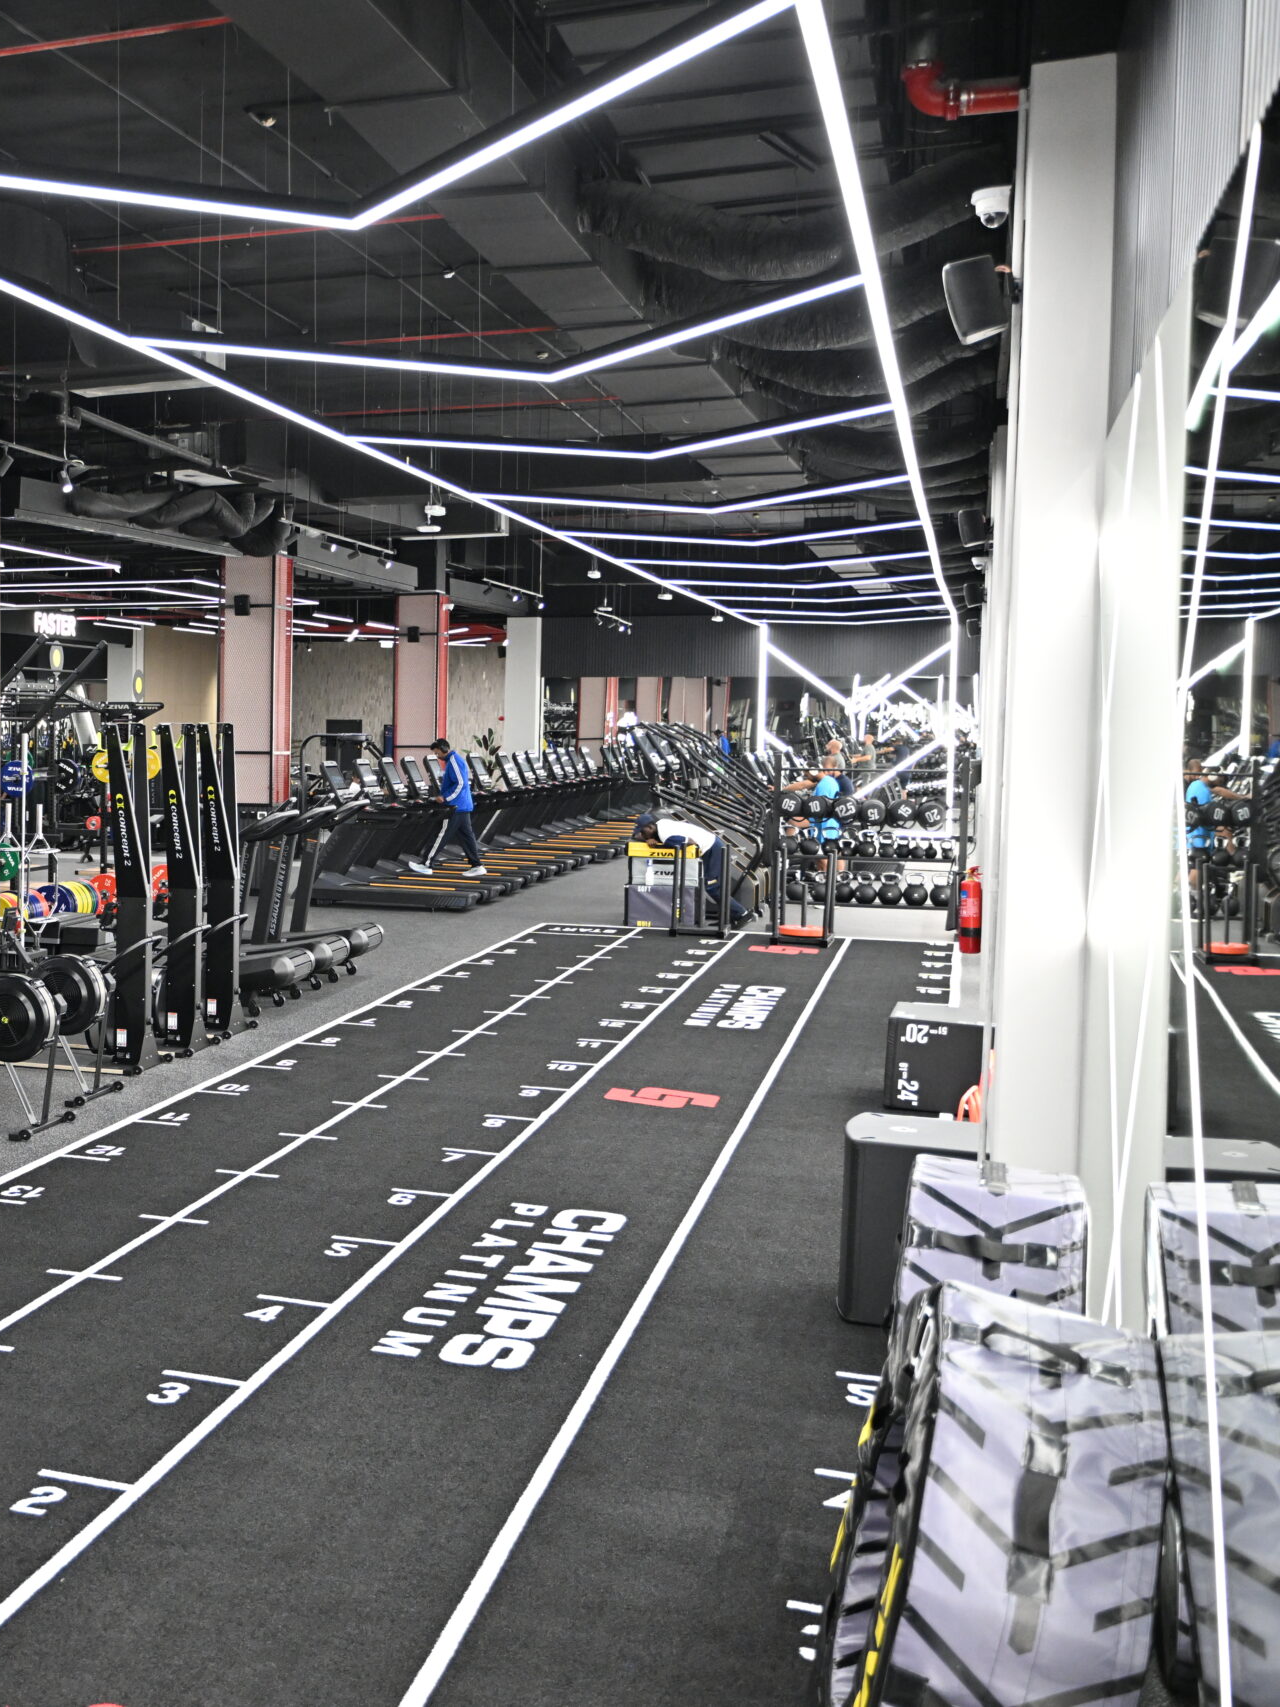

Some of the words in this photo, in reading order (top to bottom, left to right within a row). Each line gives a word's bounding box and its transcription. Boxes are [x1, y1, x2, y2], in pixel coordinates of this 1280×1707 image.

[34, 612, 76, 636] FASTER
[58, 762, 74, 775] ZIVA
[781, 798, 797, 812] 05
[808, 800, 821, 813] 10
[835, 802, 856, 818] 12.5
[898, 804, 912, 818] 15
[867, 808, 880, 820] 15
[924, 808, 941, 823] 20
[170, 805, 182, 853] concept
[209, 801, 220, 846] concept
[116, 811, 130, 860] concept
[549, 926, 618, 935] START
[716, 985, 787, 1029] CHAMPS
[576, 1041, 601, 1049] 11
[546, 1063, 577, 1072] 10
[217, 1083, 251, 1092] 10
[518, 1088, 541, 1097] 9
[158, 1112, 191, 1122] 11
[482, 1118, 507, 1128] 8
[84, 1144, 127, 1156] 12
[441, 1152, 467, 1163] 7
[0, 1185, 45, 1198] 13
[387, 1193, 417, 1206] 6
[323, 1242, 359, 1258] 5
[370, 1202, 549, 1358] PLATINUM
[438, 1208, 628, 1370] CHAMPS
[242, 1305, 285, 1322] 4
[146, 1382, 191, 1404] 3
[9, 1485, 67, 1516] 2
